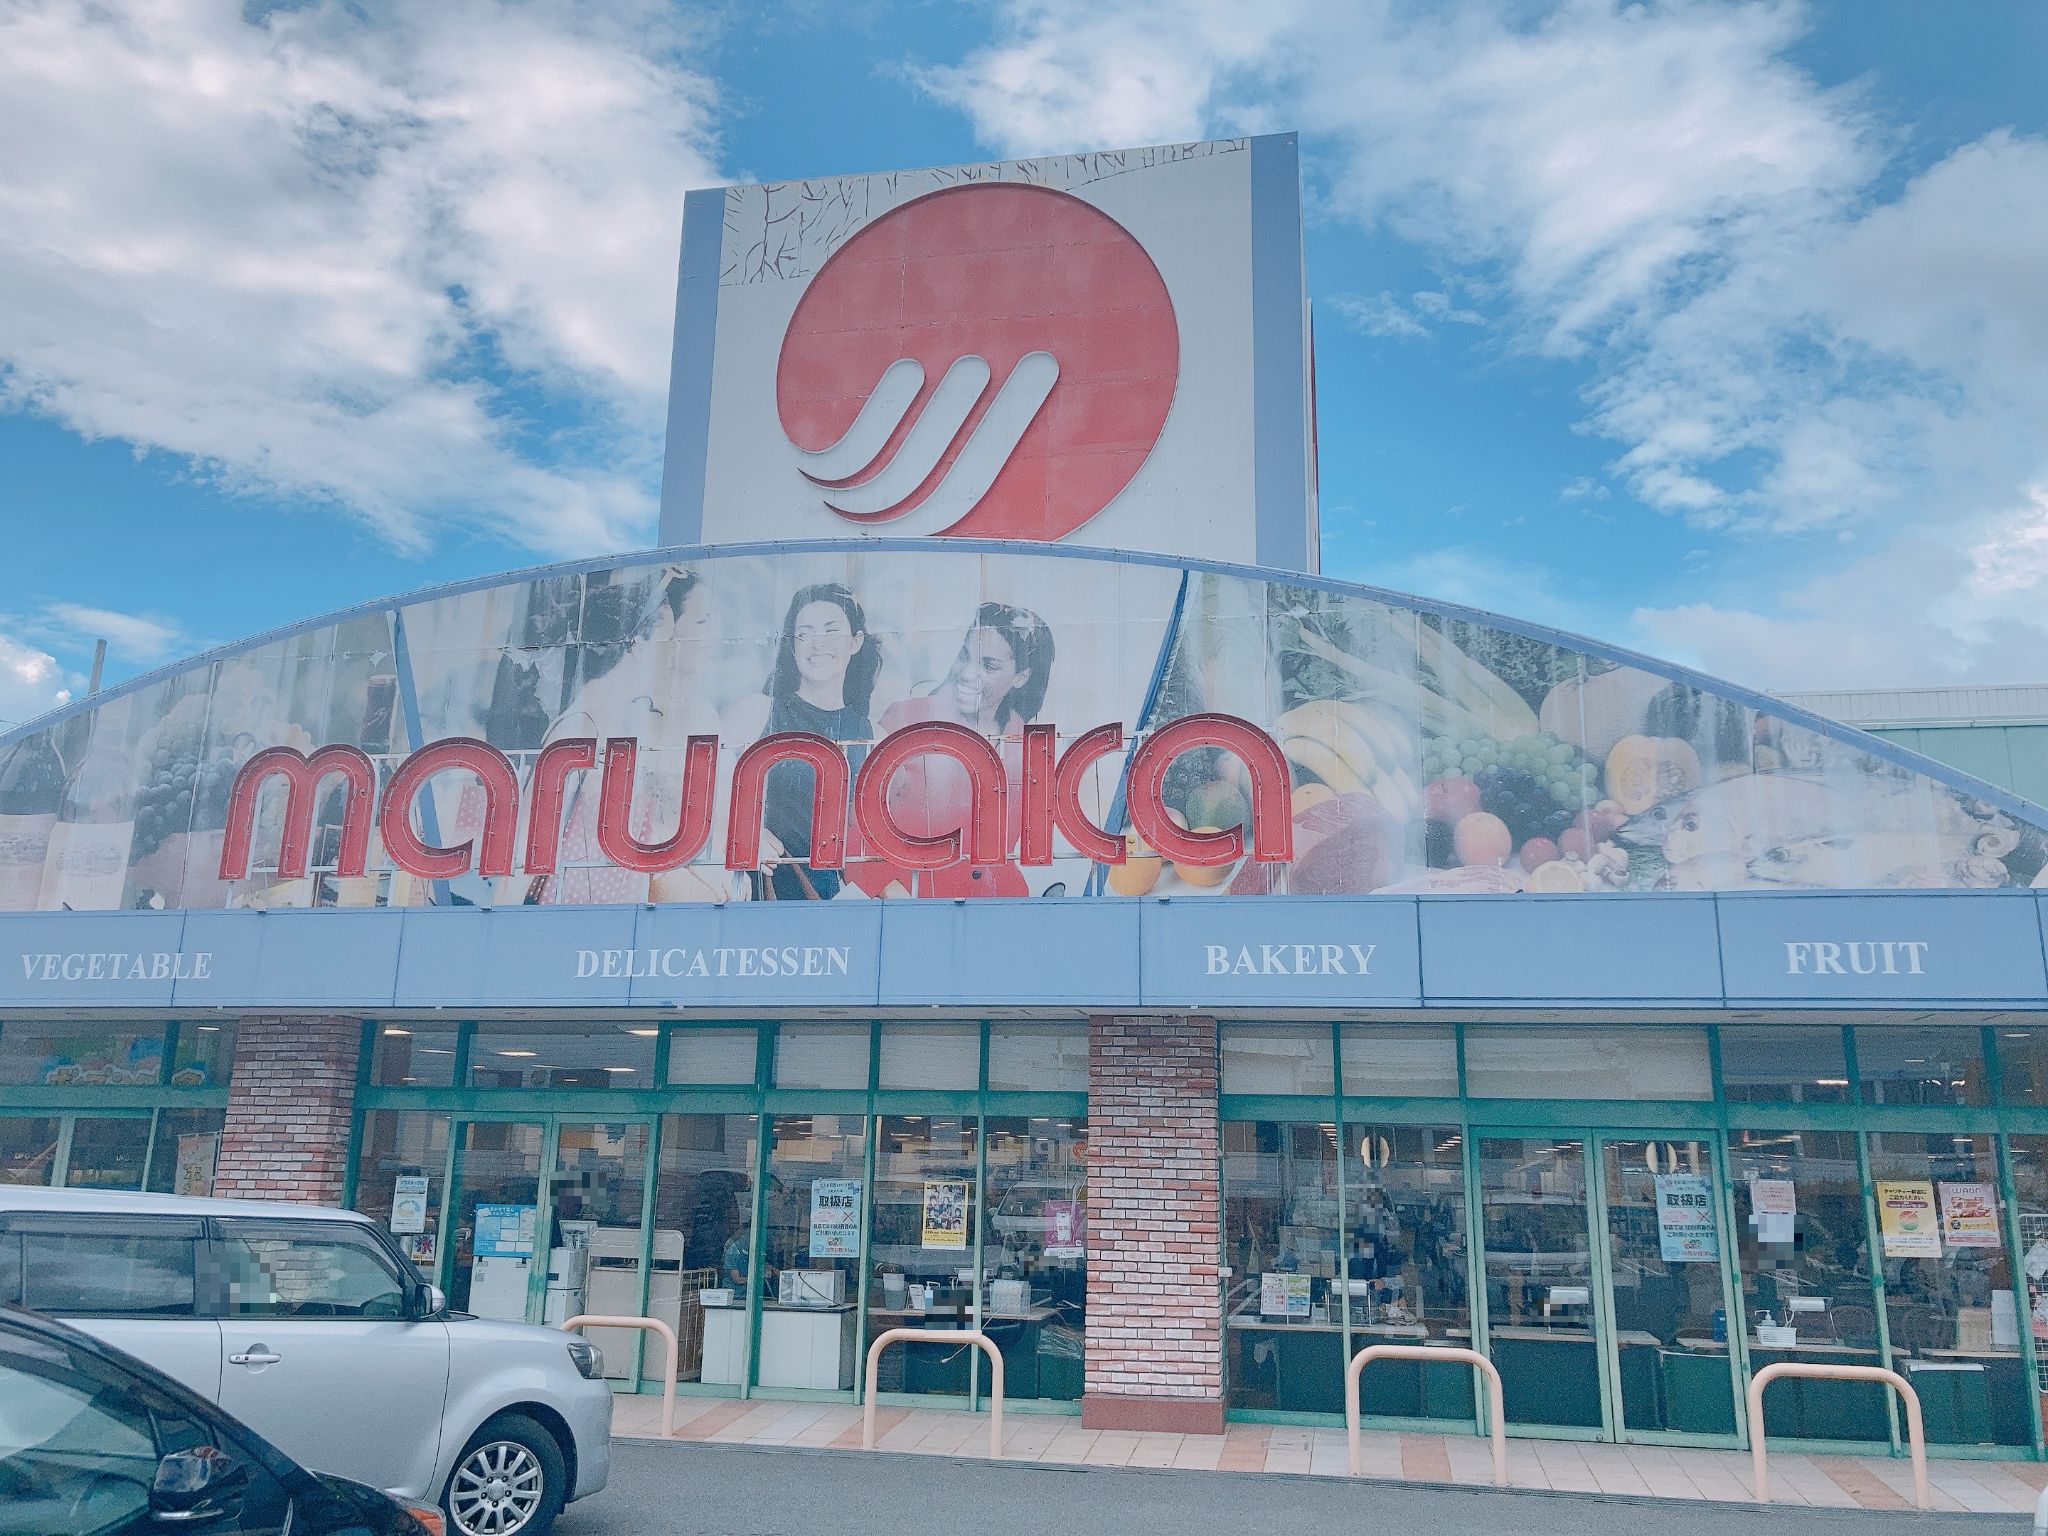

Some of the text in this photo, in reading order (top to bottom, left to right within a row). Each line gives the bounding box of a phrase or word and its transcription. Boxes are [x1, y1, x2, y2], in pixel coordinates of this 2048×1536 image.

[219, 713, 1293, 880] marunaka
[21, 952, 213, 981] VEGETABLE
[574, 946, 851, 978] DELICATESSEN
[1202, 944, 1377, 975] BAKERY
[1783, 941, 1929, 974] FRUIT
[818, 1195, 853, 1208] 取扱店
[1666, 1193, 1707, 1207] 取扱店
